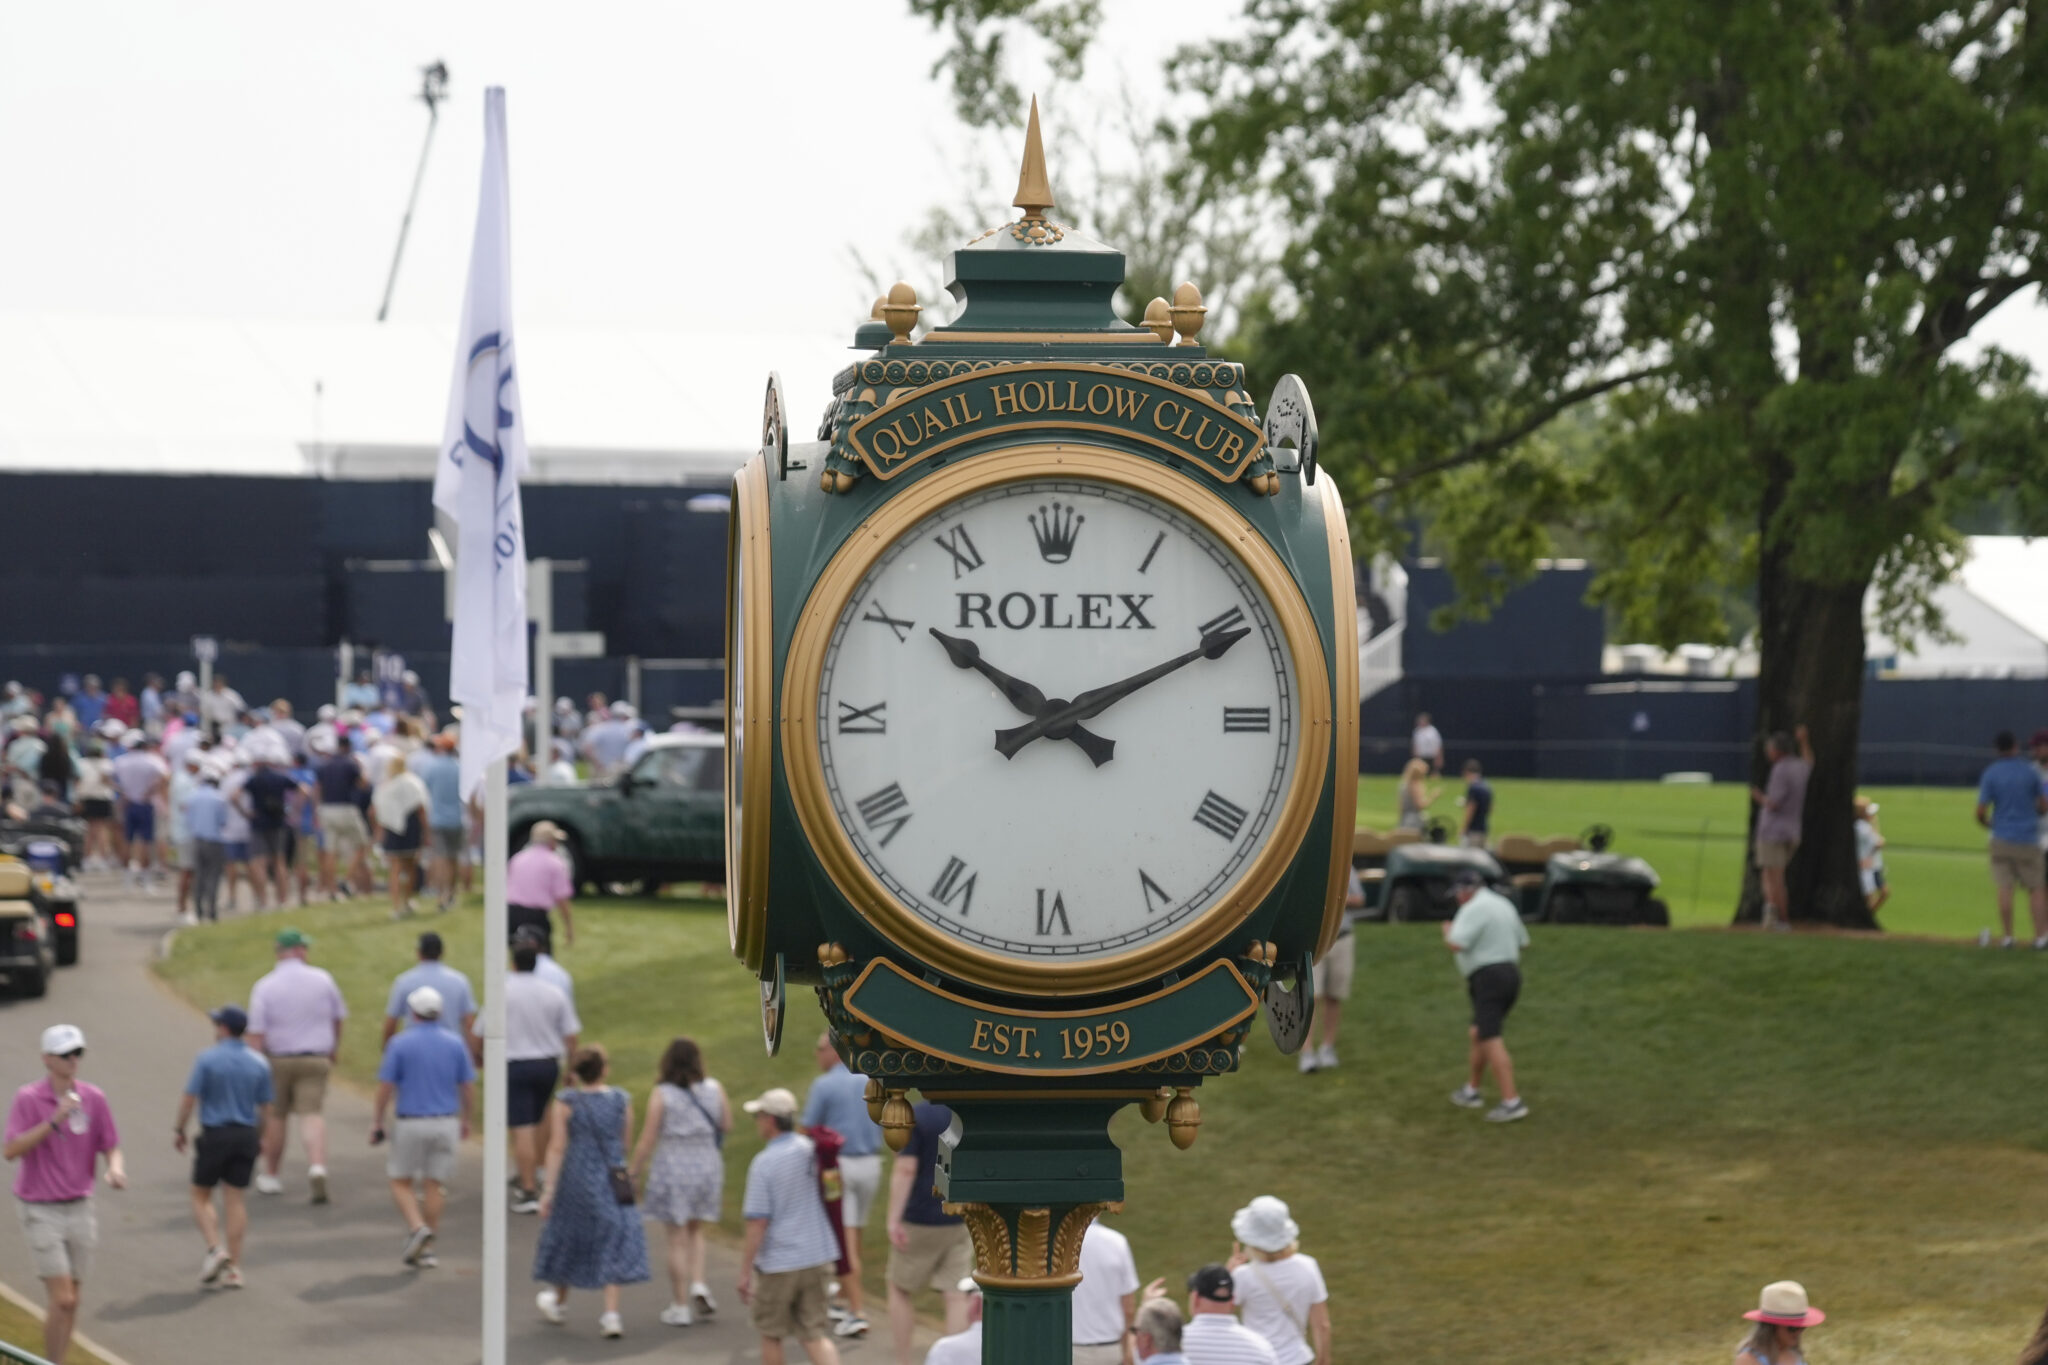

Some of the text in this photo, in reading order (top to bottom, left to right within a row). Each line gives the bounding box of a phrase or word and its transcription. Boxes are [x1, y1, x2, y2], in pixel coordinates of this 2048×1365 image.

[872, 380, 1245, 466] QUAIL HOLLOW CLUB
[954, 591, 1156, 631] ROLEX
[1223, 706, 1271, 734] III
[1192, 788, 1249, 843] IIII
[969, 1019, 1131, 1060] EST. 1959
